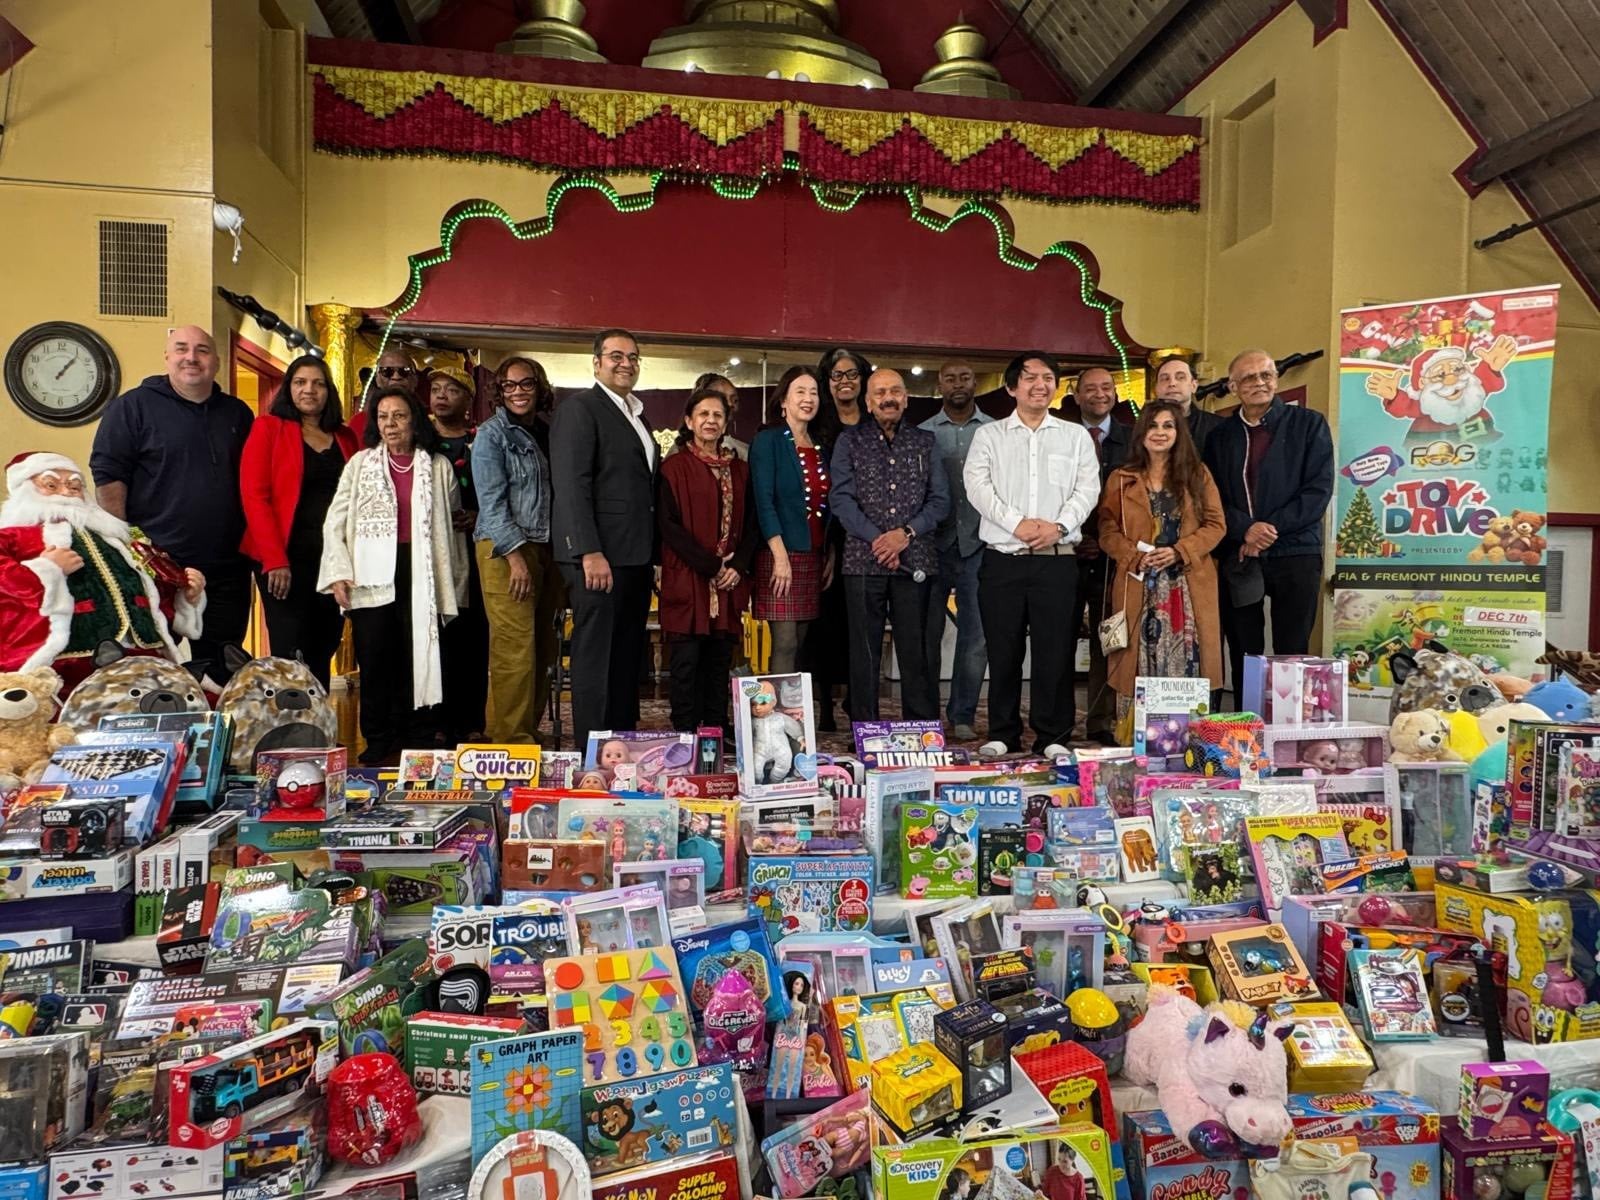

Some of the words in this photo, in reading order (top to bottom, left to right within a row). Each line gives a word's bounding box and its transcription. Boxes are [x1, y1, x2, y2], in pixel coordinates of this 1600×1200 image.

[42, 343, 49, 354] 11
[57, 342, 66, 351] 12
[1396, 479, 1477, 508] TOY
[1411, 547, 1453, 555] PRESENTED
[1454, 546, 1463, 554] BY
[1338, 573, 1358, 581] FIA
[1361, 573, 1371, 581] &
[1375, 572, 1436, 582] FREMONT
[1440, 573, 1482, 582] HINDU
[1486, 573, 1541, 583] TEMPLE
[1478, 611, 1506, 622] DEC
[1508, 613, 1528, 624] 7th
[1452, 627, 1485, 635] Fremont
[1487, 628, 1511, 636] Hindu
[1512, 629, 1543, 638] Temple
[929, 733, 936, 741] 3
[876, 751, 954, 767] ULTIMATE
[476, 760, 533, 775] QUICK!
[404, 790, 474, 801] BASKETBALL
[944, 788, 986, 806] THIN
[989, 789, 1019, 806] ICE
[1281, 816, 1305, 827] SUPER
[1305, 815, 1338, 825] ACTIVITY
[348, 832, 391, 846] PINBALL
[163, 859, 171, 886] PEANUTS
[795, 861, 825, 872] SUPER
[825, 861, 870, 872] ACTIVITY
[1372, 860, 1406, 871] HOCKEY
[43, 867, 86, 880] wheel
[141, 860, 150, 888] PEANUTS
[244, 871, 276, 883] DINO
[754, 866, 791, 884] GRINCH
[852, 880, 857, 888] 3
[439, 923, 490, 949] SOR
[498, 919, 568, 944] TROUBL
[673, 937, 709, 952] Disney
[7, 944, 73, 969] PINBALL
[162, 950, 208, 963] WAR
[980, 961, 1028, 980] DEFENDER
[355, 983, 384, 1009] DINO
[411, 1029, 448, 1039] Christmas
[449, 1032, 468, 1041] small
[470, 1034, 489, 1042] train
[583, 1023, 602, 1053] 2
[610, 1019, 632, 1046] 3
[641, 1015, 662, 1042] 4
[665, 1011, 687, 1038] 5
[498, 1039, 537, 1057] GRAPH
[541, 1035, 577, 1050] PAPER
[775, 1033, 803, 1049] Barbie
[103, 1055, 150, 1065] MONSTER
[527, 1051, 550, 1064] ART
[586, 1051, 606, 1080] 7
[616, 1047, 637, 1077] 8
[645, 1042, 665, 1071] 9
[670, 1038, 692, 1067] 0
[117, 1062, 137, 1070] JAM
[678, 1067, 724, 1086] Puzzles
[803, 1074, 837, 1090] Barbie
[1294, 1118, 1327, 1133] ORIGINAL
[1296, 1121, 1344, 1141] Bazooka
[1151, 1144, 1191, 1162] Bazoo
[677, 1171, 716, 1191] SUPER
[908, 1170, 938, 1182] KIDS
[1151, 1165, 1231, 1200] Candy
[225, 1187, 260, 1200] BLAZING
[668, 1181, 727, 1200] COLORING
